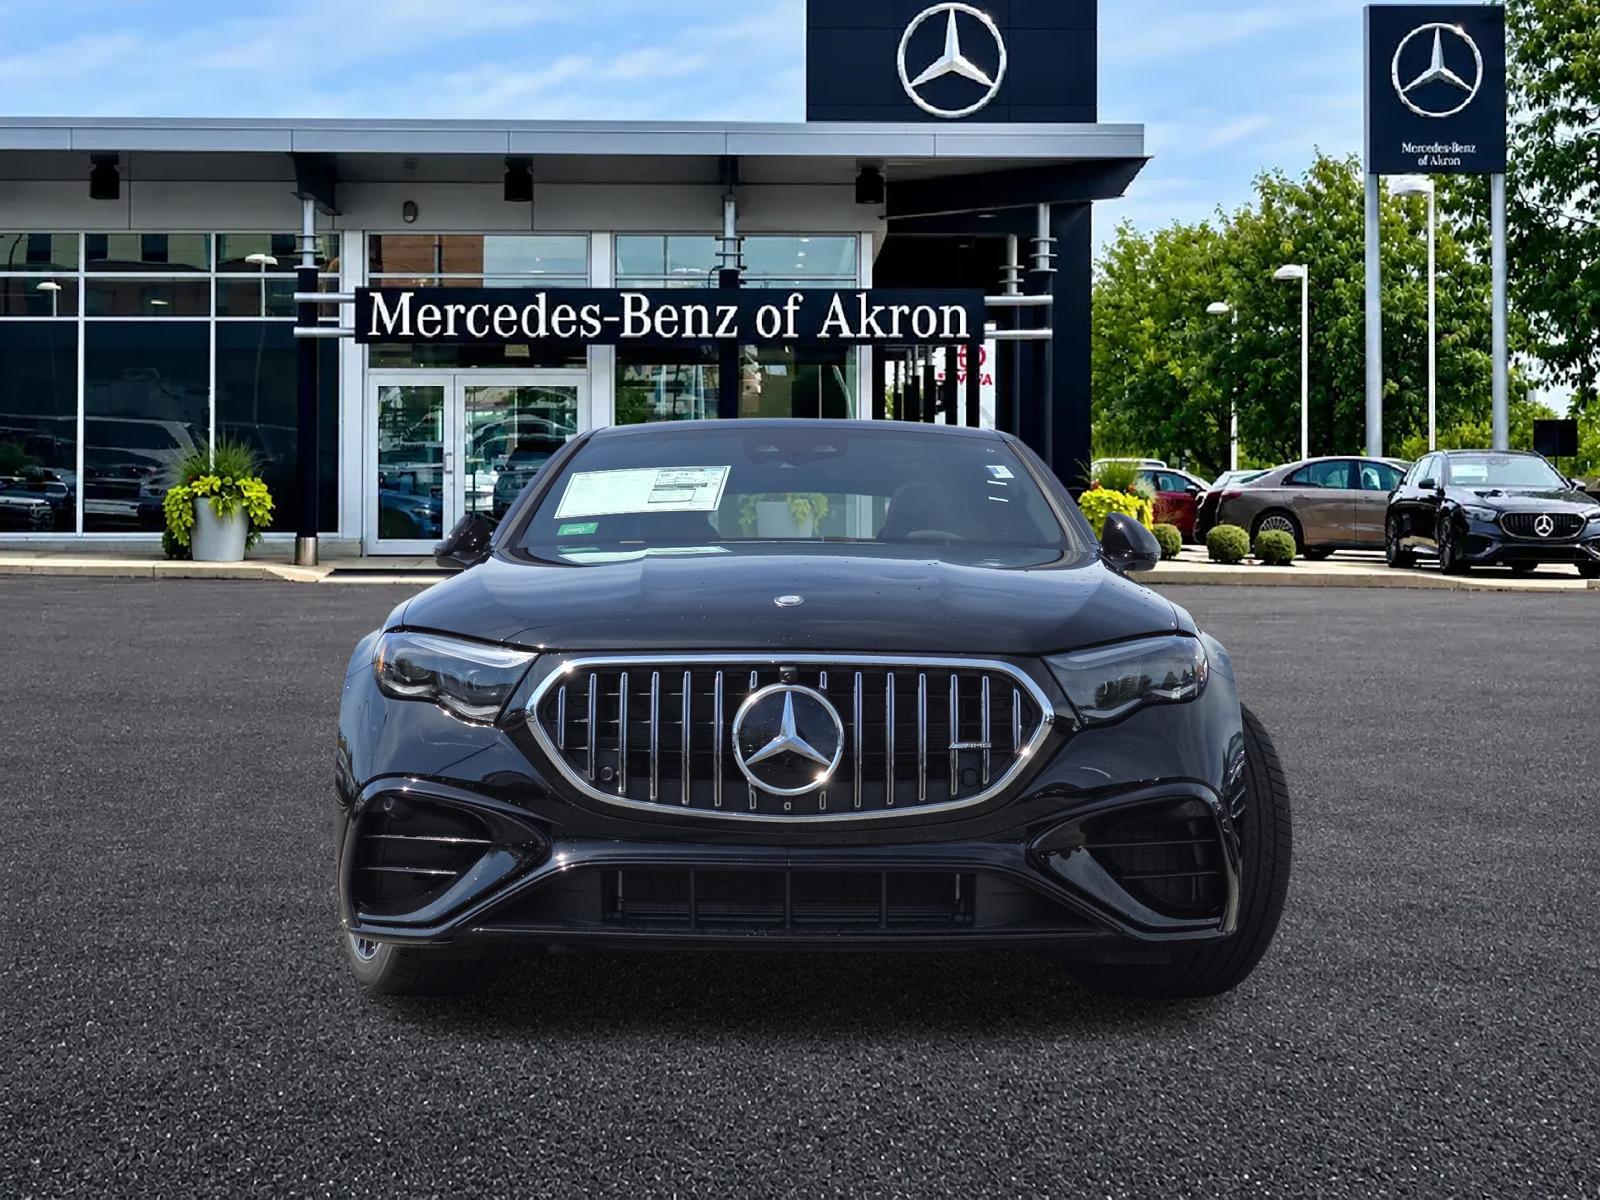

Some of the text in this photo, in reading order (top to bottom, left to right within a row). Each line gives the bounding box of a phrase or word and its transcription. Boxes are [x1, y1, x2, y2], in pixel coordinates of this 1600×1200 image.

[1401, 141, 1477, 154] Mercedes-Benz
[1417, 154, 1461, 166] of Akron
[367, 292, 970, 338] Mercedes-Benz of Akron
